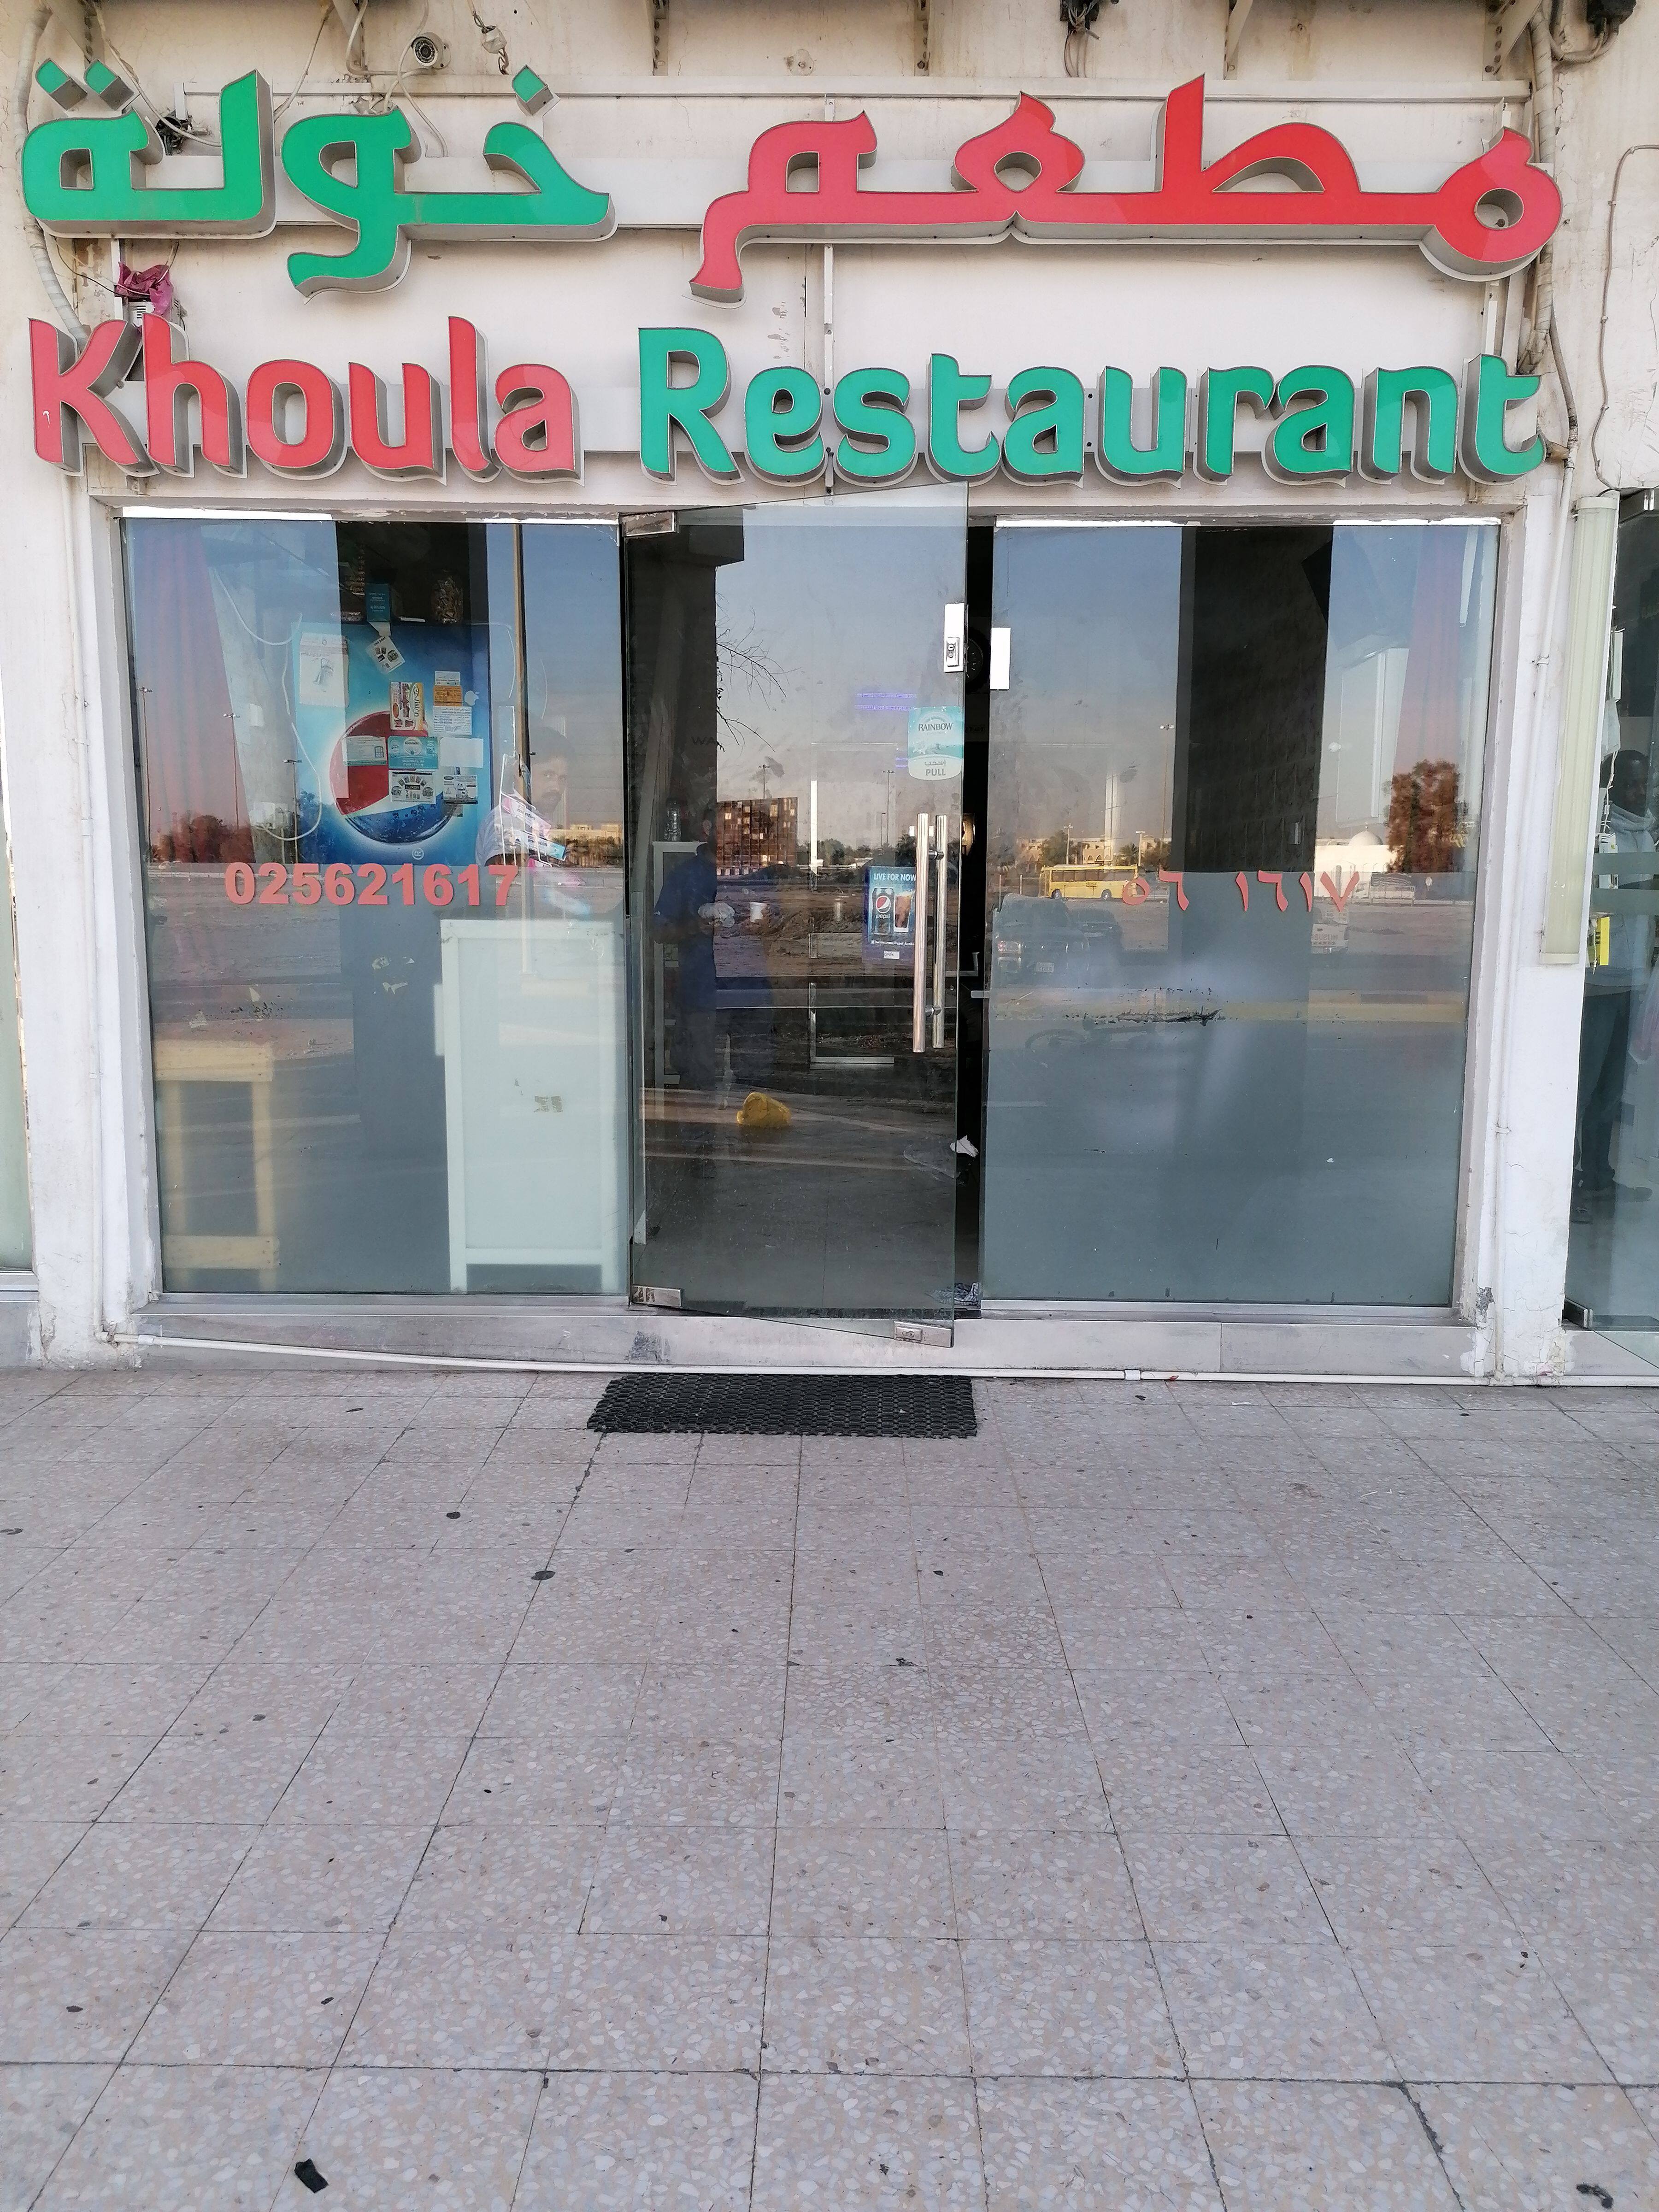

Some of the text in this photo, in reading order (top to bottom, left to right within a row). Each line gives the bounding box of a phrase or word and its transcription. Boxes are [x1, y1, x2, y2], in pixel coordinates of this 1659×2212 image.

[21, 59, 1564, 289] مطعم خولة
[28, 307, 1545, 477] Khoula Restaurant
[918, 722, 953, 731] RAINBOW
[926, 768, 946, 777] PULL
[225, 862, 519, 906] 025621617
